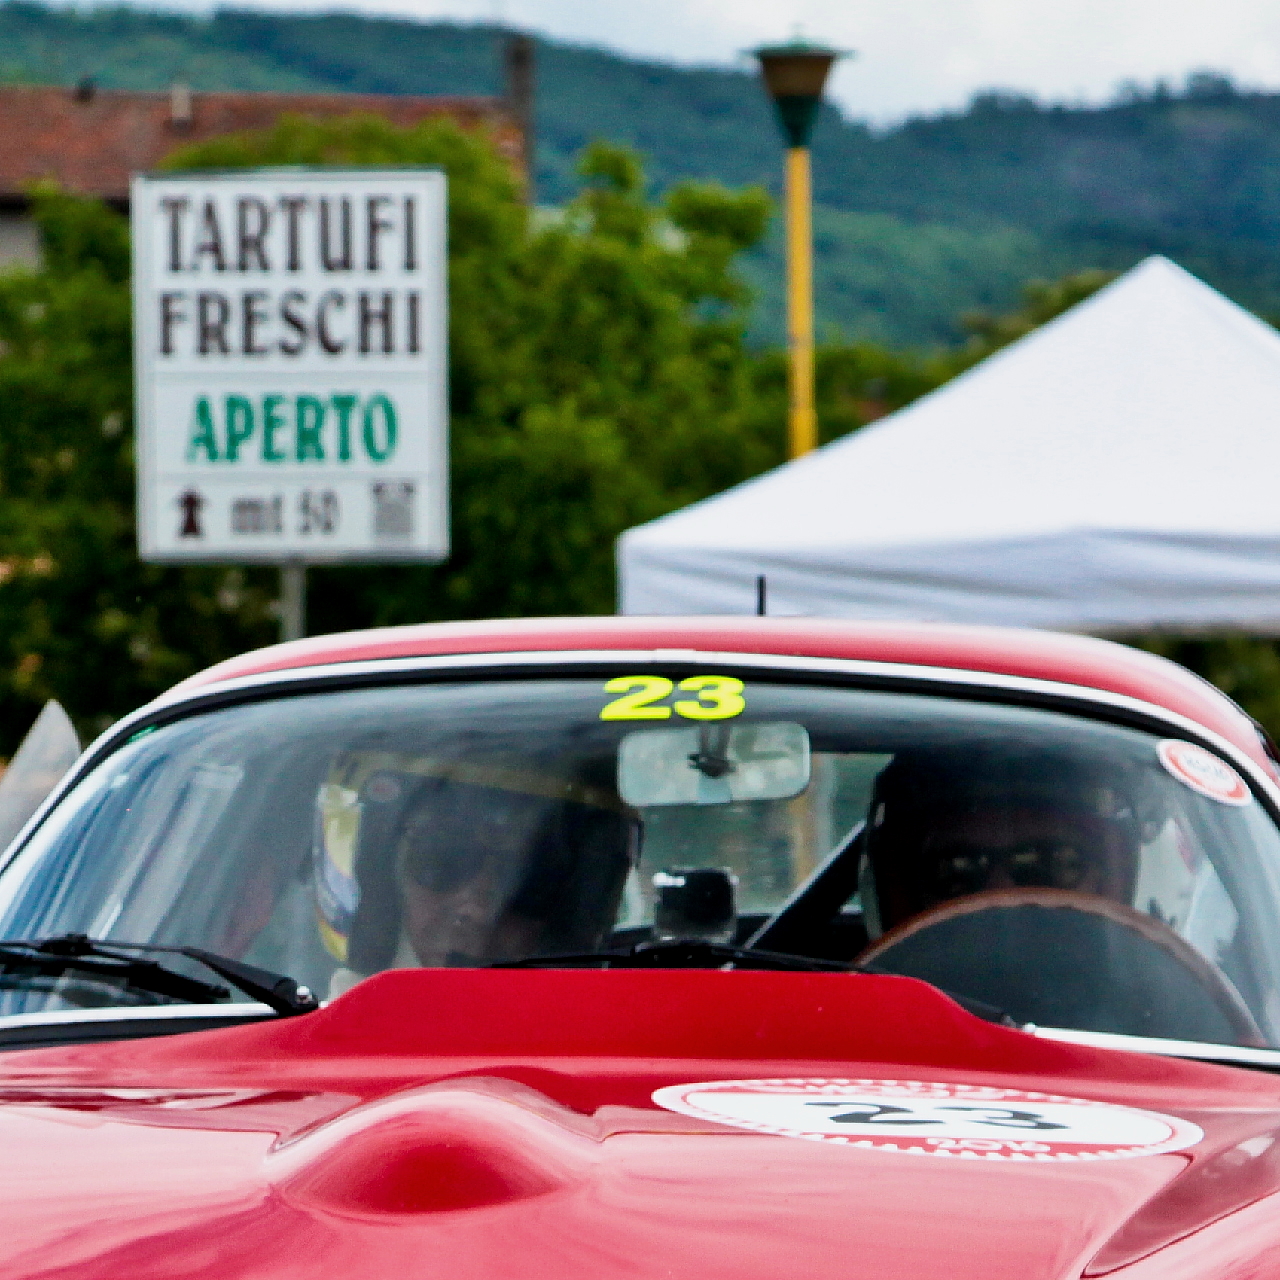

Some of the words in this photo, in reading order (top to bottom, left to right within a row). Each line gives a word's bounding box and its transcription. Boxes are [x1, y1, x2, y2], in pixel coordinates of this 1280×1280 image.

[159, 194, 419, 271] TARTUFI
[158, 290, 421, 356] FRESCHI
[185, 392, 398, 463] APERTO
[600, 676, 745, 720] 23
[805, 1101, 1070, 1130] 23
